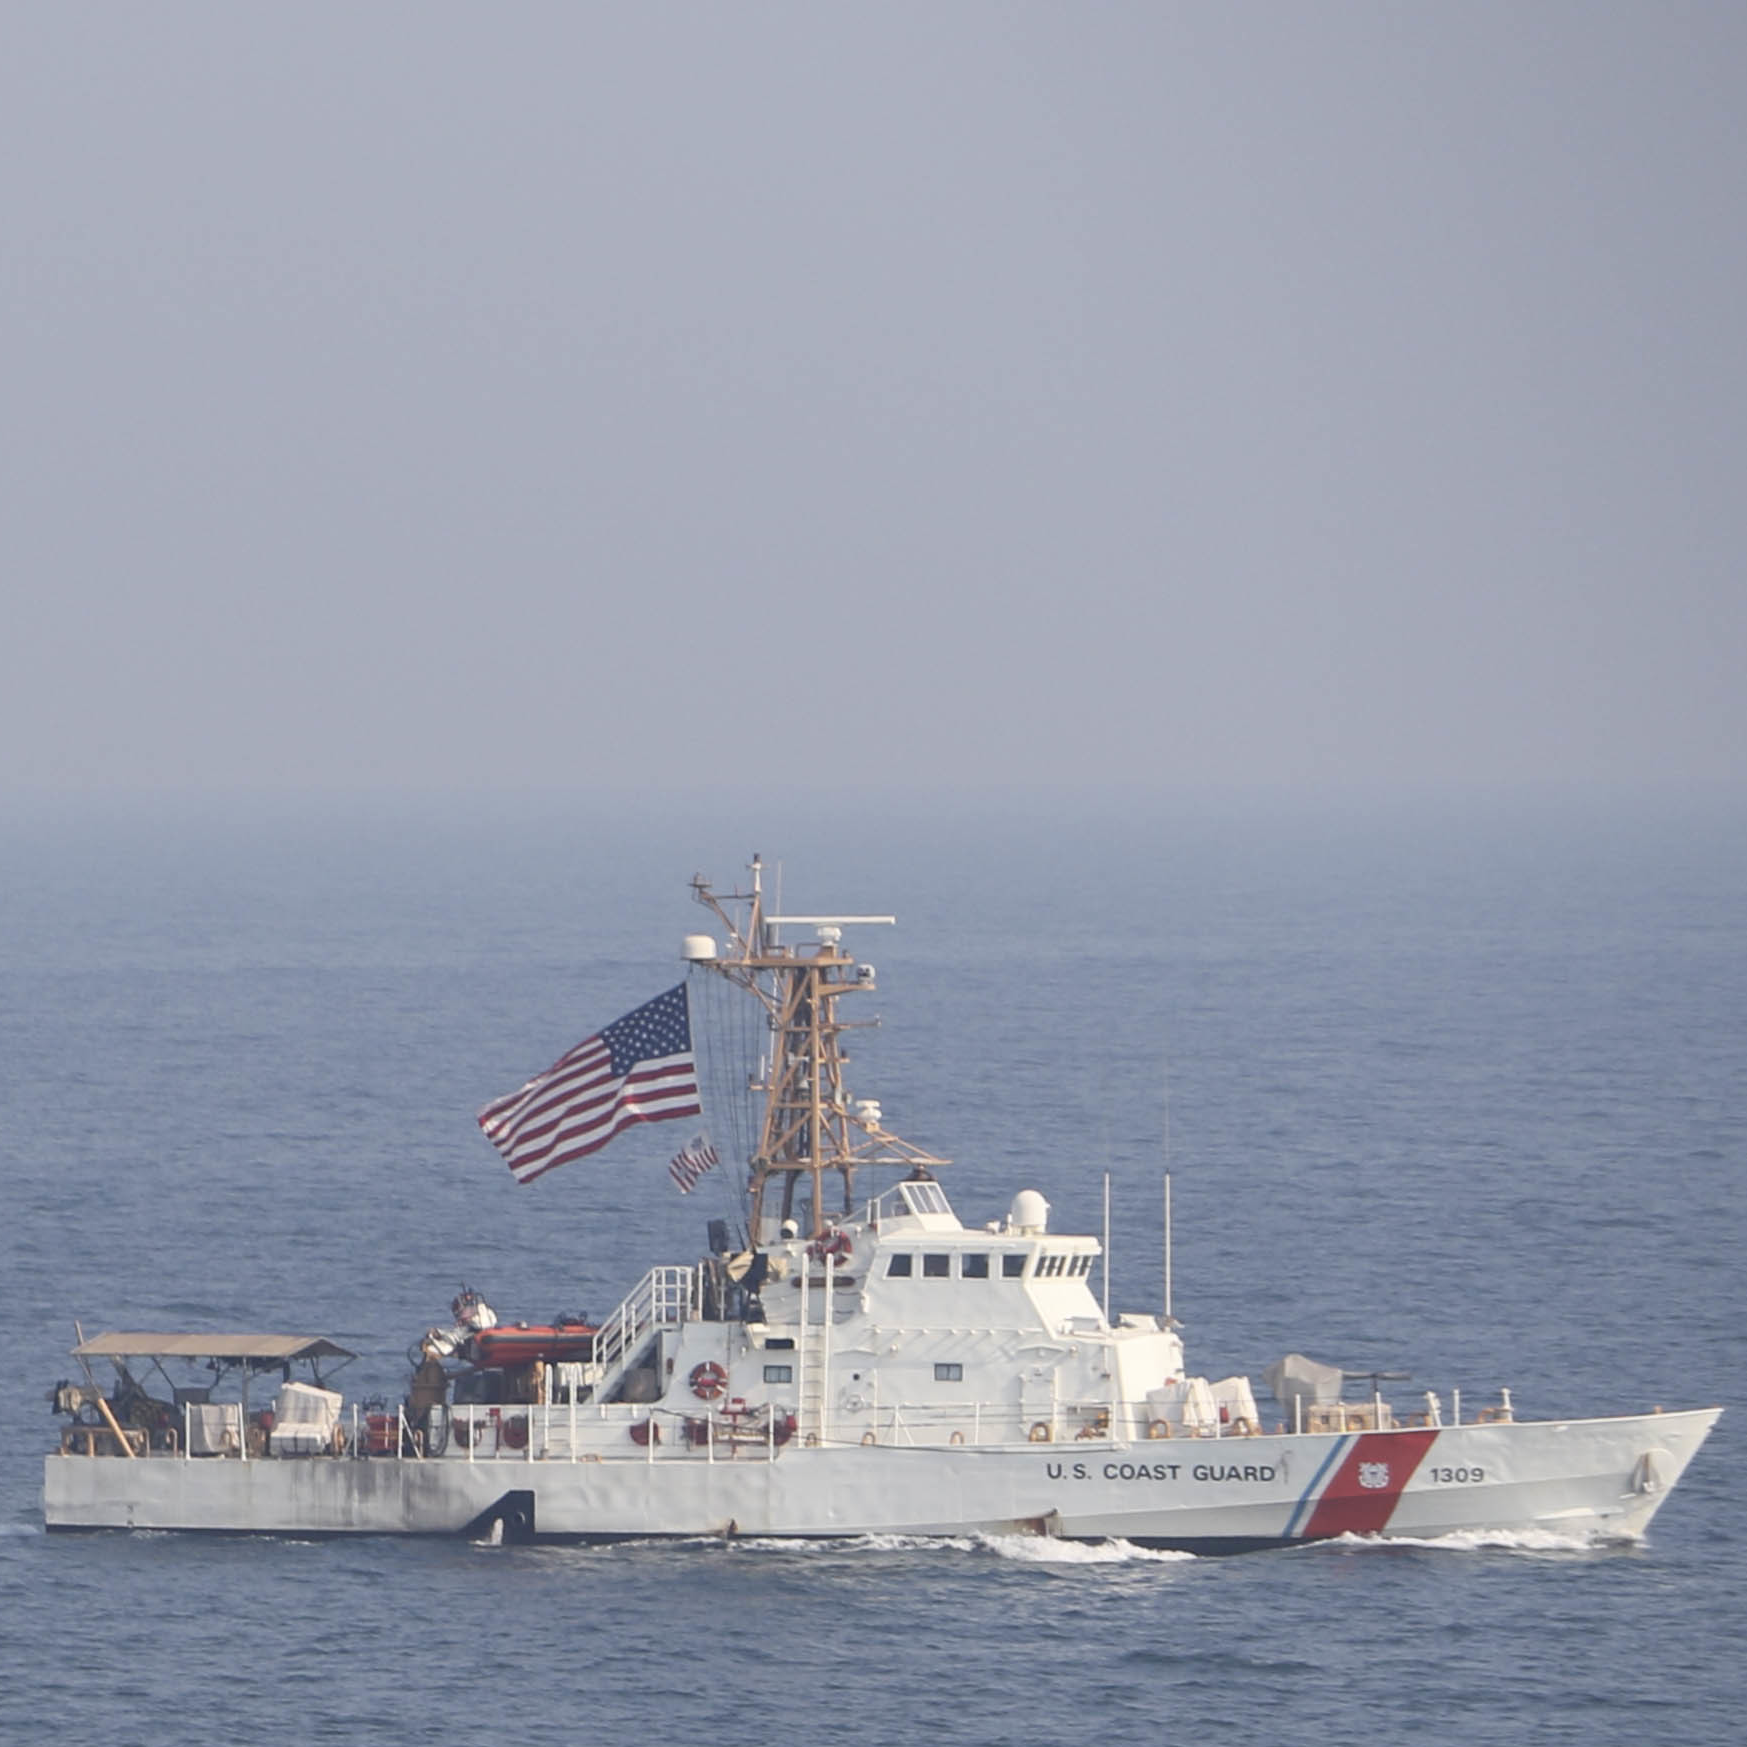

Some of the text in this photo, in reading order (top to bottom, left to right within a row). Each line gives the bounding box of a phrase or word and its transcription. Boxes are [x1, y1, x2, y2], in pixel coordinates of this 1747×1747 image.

[1047, 1463, 1275, 1481] U.S. COAST GUARD
[1430, 1467, 1484, 1483] 1309
